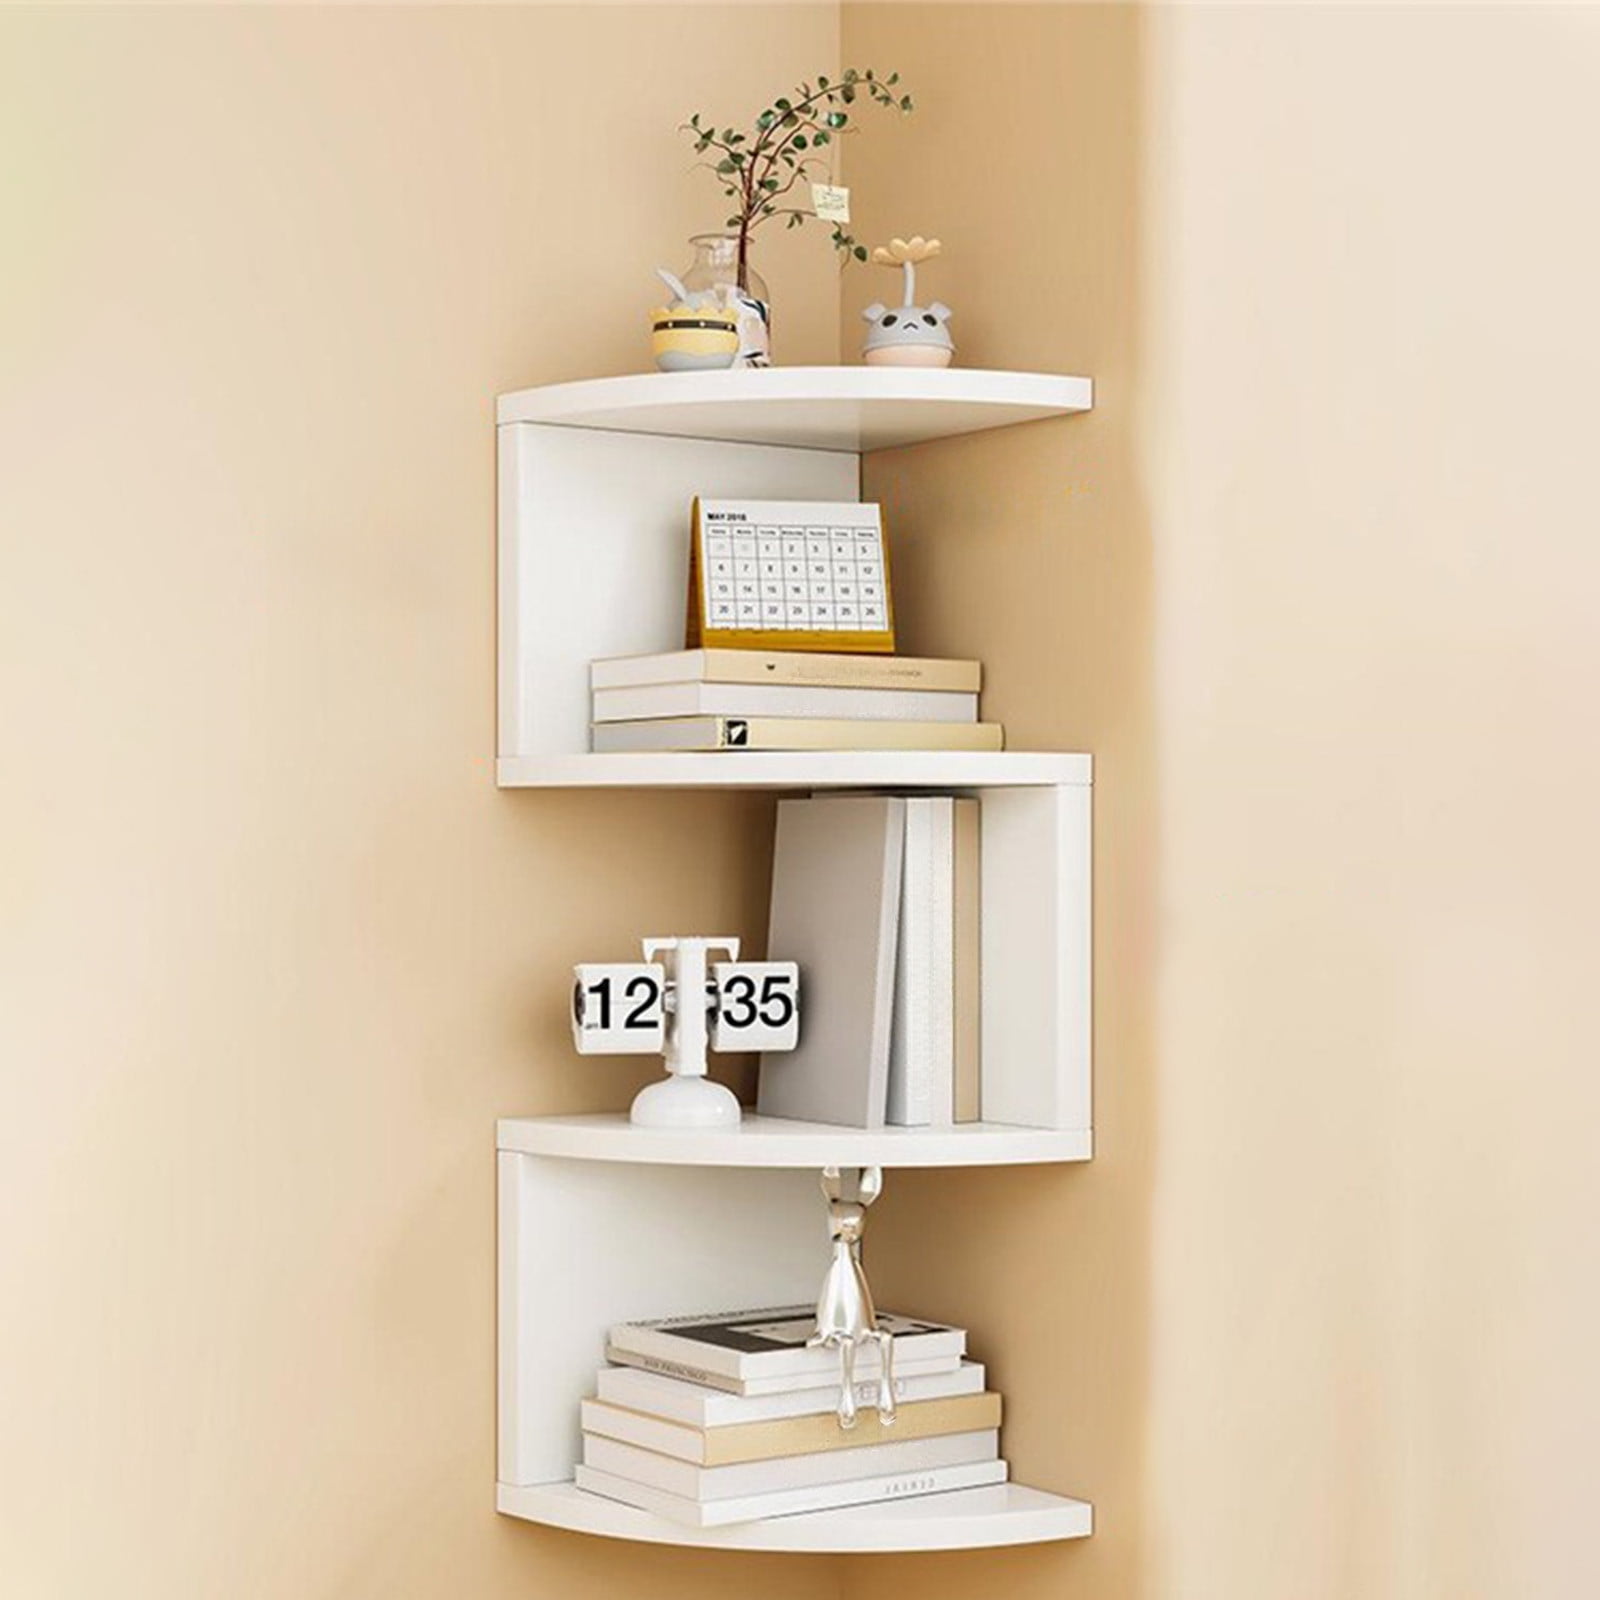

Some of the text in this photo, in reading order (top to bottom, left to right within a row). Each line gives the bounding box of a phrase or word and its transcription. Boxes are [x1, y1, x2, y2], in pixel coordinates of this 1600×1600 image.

[707, 513, 725, 521] MAY
[788, 544, 795, 553] 2
[588, 975, 793, 1029] 12 35
